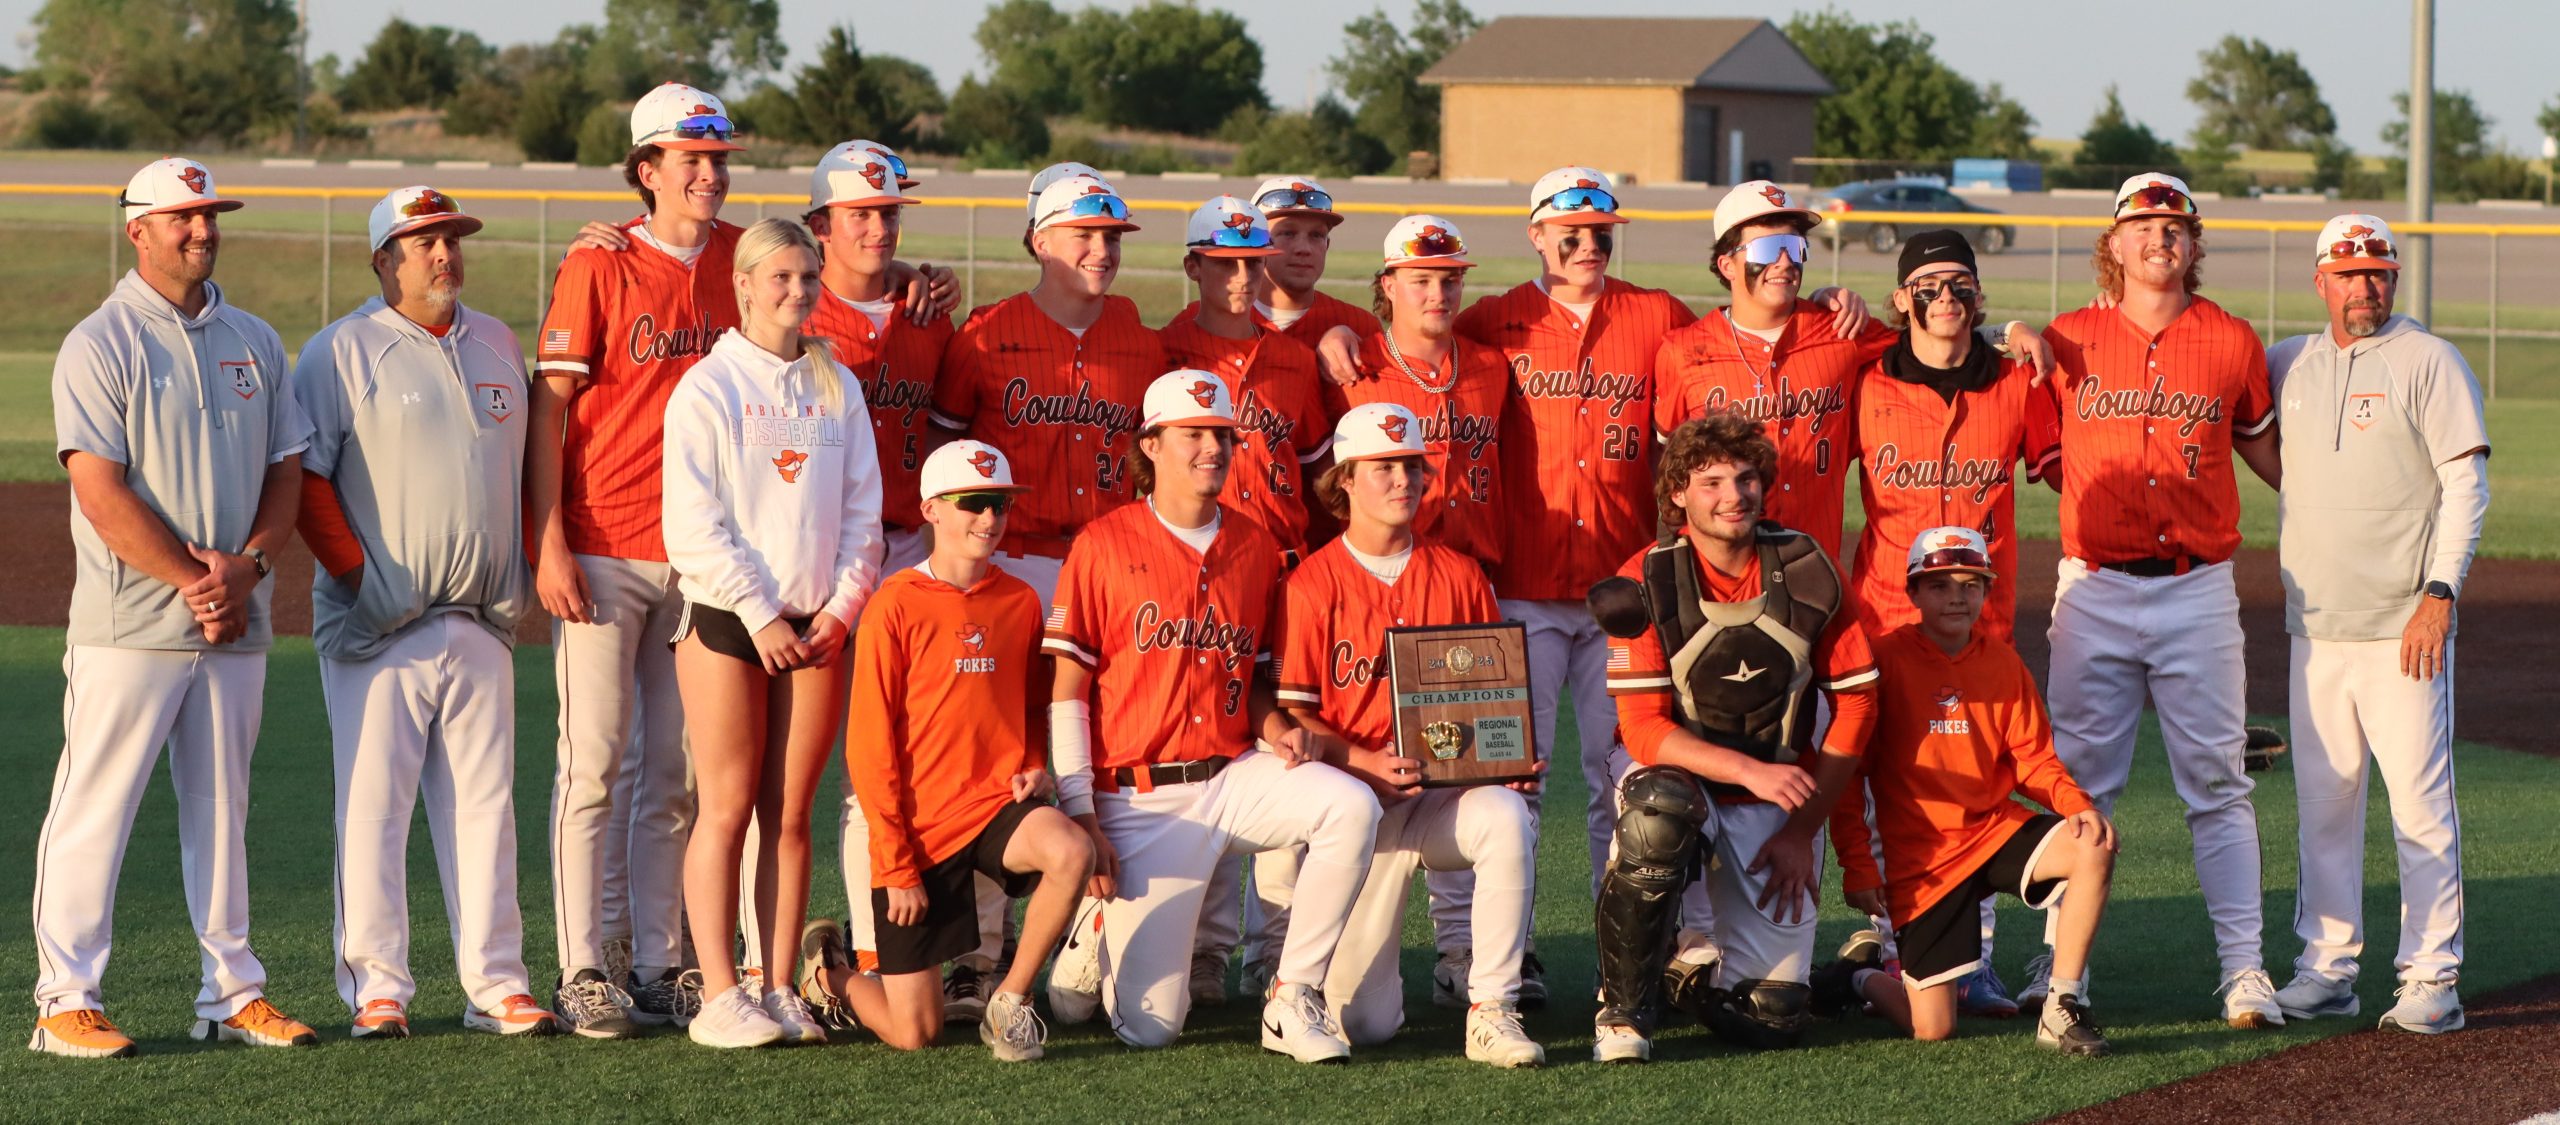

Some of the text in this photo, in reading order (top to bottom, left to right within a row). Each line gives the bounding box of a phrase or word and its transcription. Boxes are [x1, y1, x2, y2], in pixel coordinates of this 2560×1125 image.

[629, 312, 724, 366] Cowb
[1512, 354, 1648, 418] Cowboys
[745, 404, 826, 417] ABILNE
[1003, 377, 1136, 447] Cowboys
[2077, 375, 2223, 438] Cowboys
[728, 415, 844, 447] BASEBALL
[1418, 400, 1499, 461] wboys
[1603, 423, 1641, 461] 26
[902, 433, 918, 472] 5
[1816, 438, 1831, 475] 0
[2182, 444, 2201, 479] 7
[1468, 465, 1491, 504] 12
[1873, 443, 2010, 504] Cowboys
[1980, 509, 1995, 544] 4
[1135, 600, 1256, 672] Cowboys
[955, 657, 995, 674] POKES
[1225, 678, 1243, 717] 3
[1411, 689, 1515, 705] CHAMPIONS
[1479, 719, 1518, 730] REGIONAL
[1491, 732, 1508, 741] BOYS
[1929, 719, 1969, 735] POKES
[1485, 741, 1515, 749] BASEBALL
